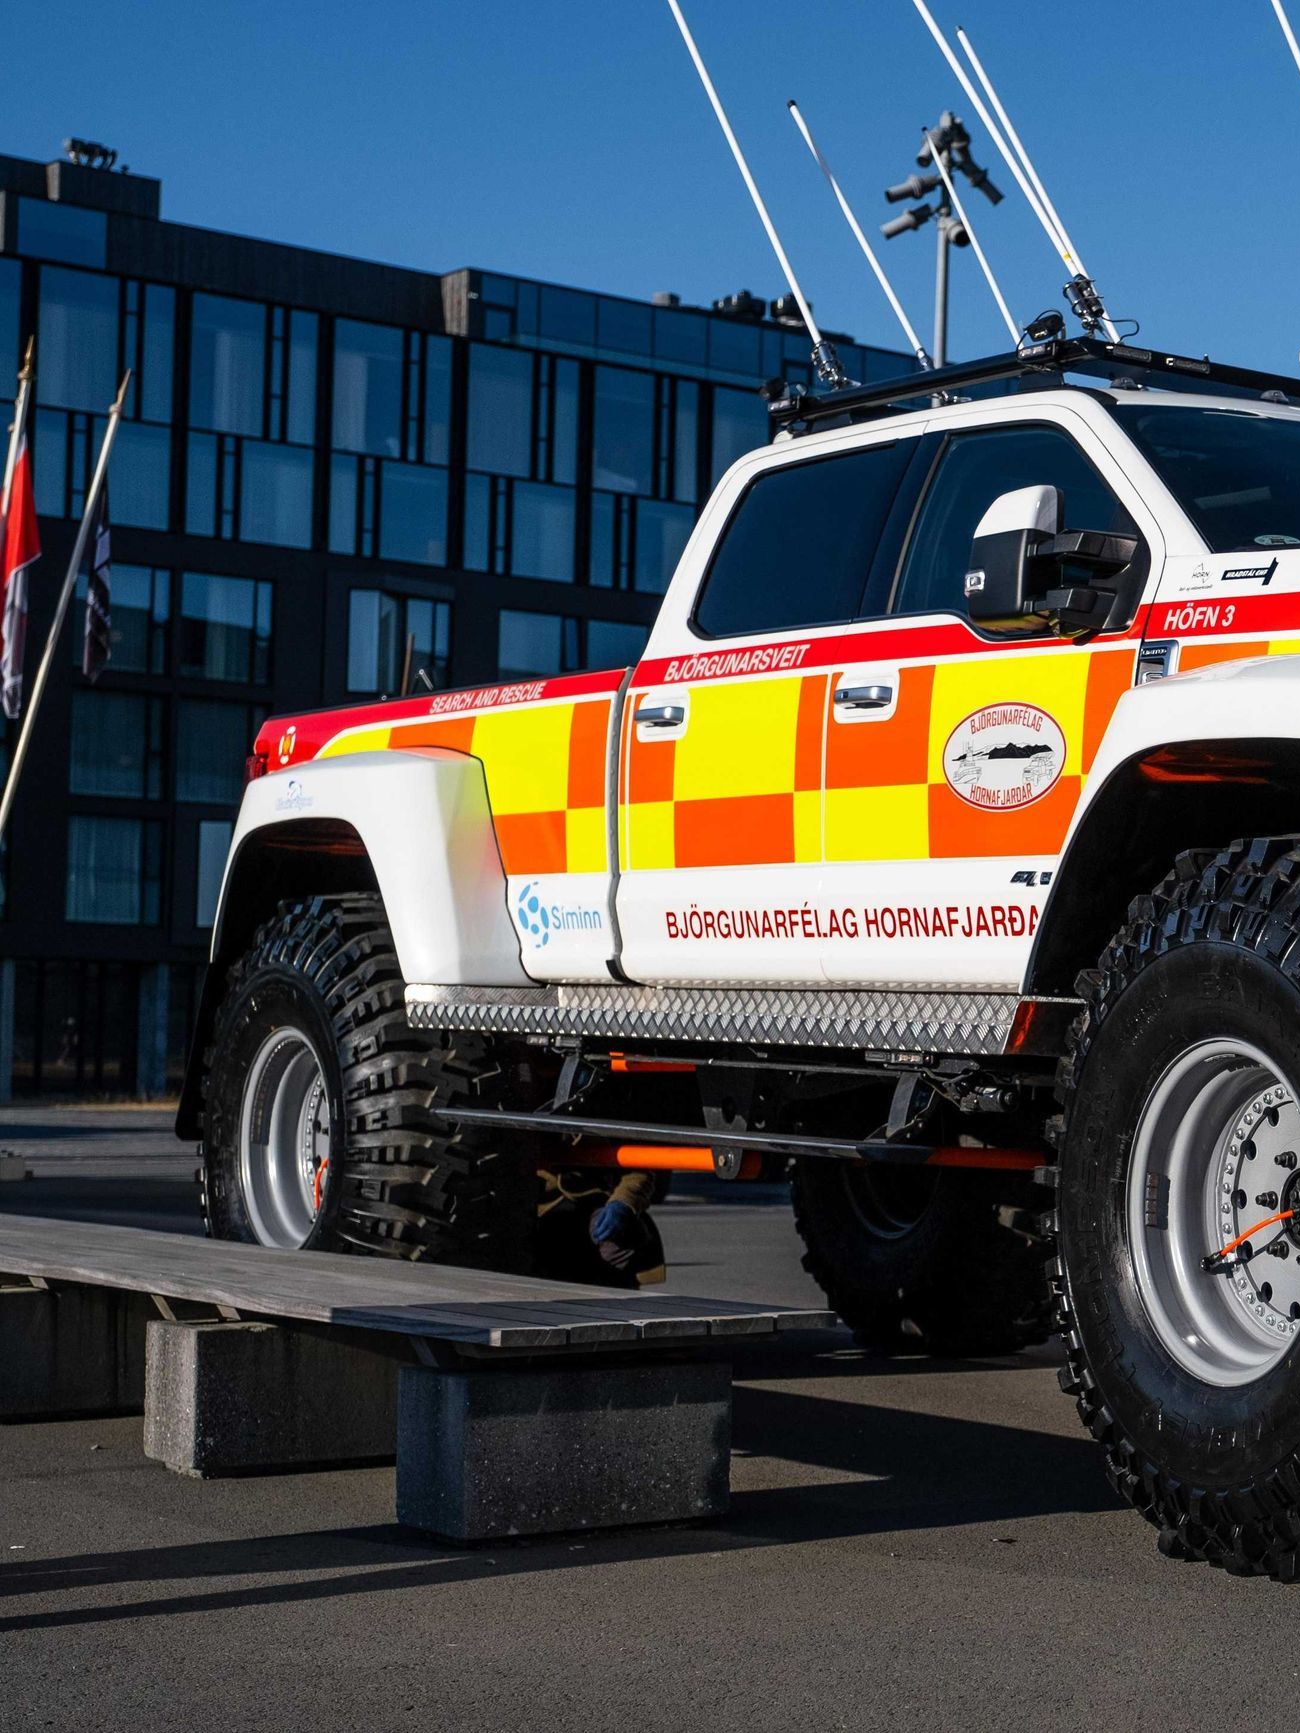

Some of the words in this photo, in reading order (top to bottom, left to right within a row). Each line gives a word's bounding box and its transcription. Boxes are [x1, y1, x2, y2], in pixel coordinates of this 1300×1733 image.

[1164, 602, 1221, 631] HÖFN
[1221, 604, 1236, 627] 3
[664, 643, 811, 682] BJÖRGUNARSVEIT
[429, 691, 475, 715] SEARCH
[472, 687, 502, 707] AND
[498, 681, 548, 704] RESCUE
[970, 706, 1044, 735] BJÖRGUNARFÉLAG
[551, 904, 602, 930] Síminn
[665, 901, 858, 940] BJÖRGUNARFÉLAG
